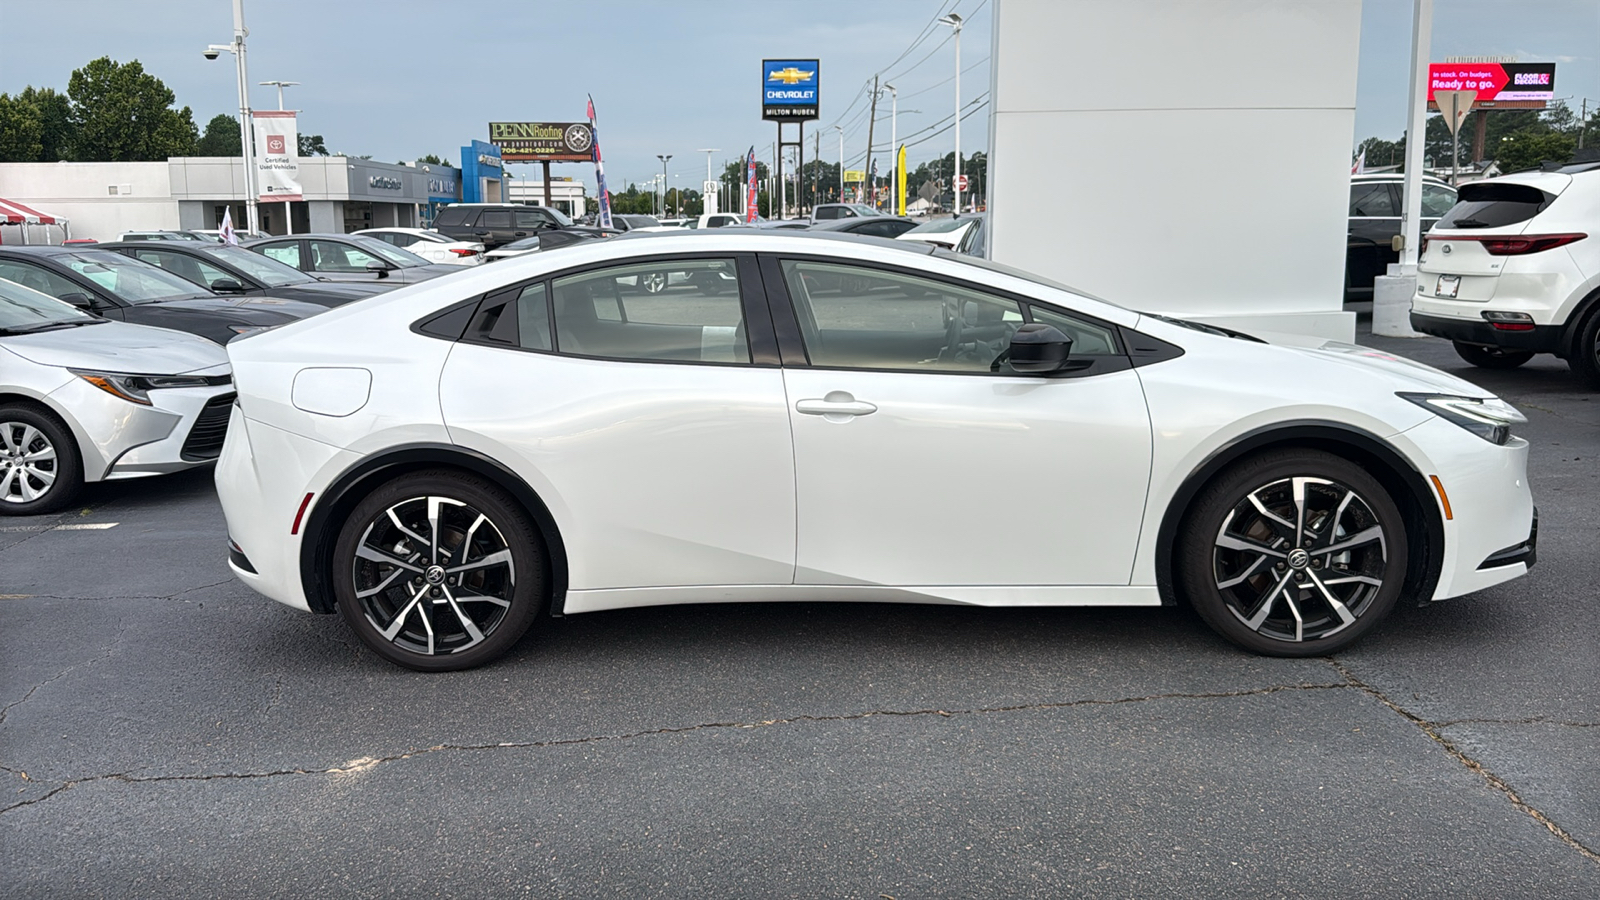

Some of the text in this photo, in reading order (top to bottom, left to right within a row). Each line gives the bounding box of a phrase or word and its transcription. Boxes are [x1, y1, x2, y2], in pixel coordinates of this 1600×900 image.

[1469, 71, 1493, 79] budget.
[1432, 79, 1495, 90] Ready to go.
[767, 90, 815, 99] CHEVROLET
[766, 108, 816, 116] MILTON RUBEN
[491, 123, 537, 137] PENN
[534, 125, 563, 140] Roofing
